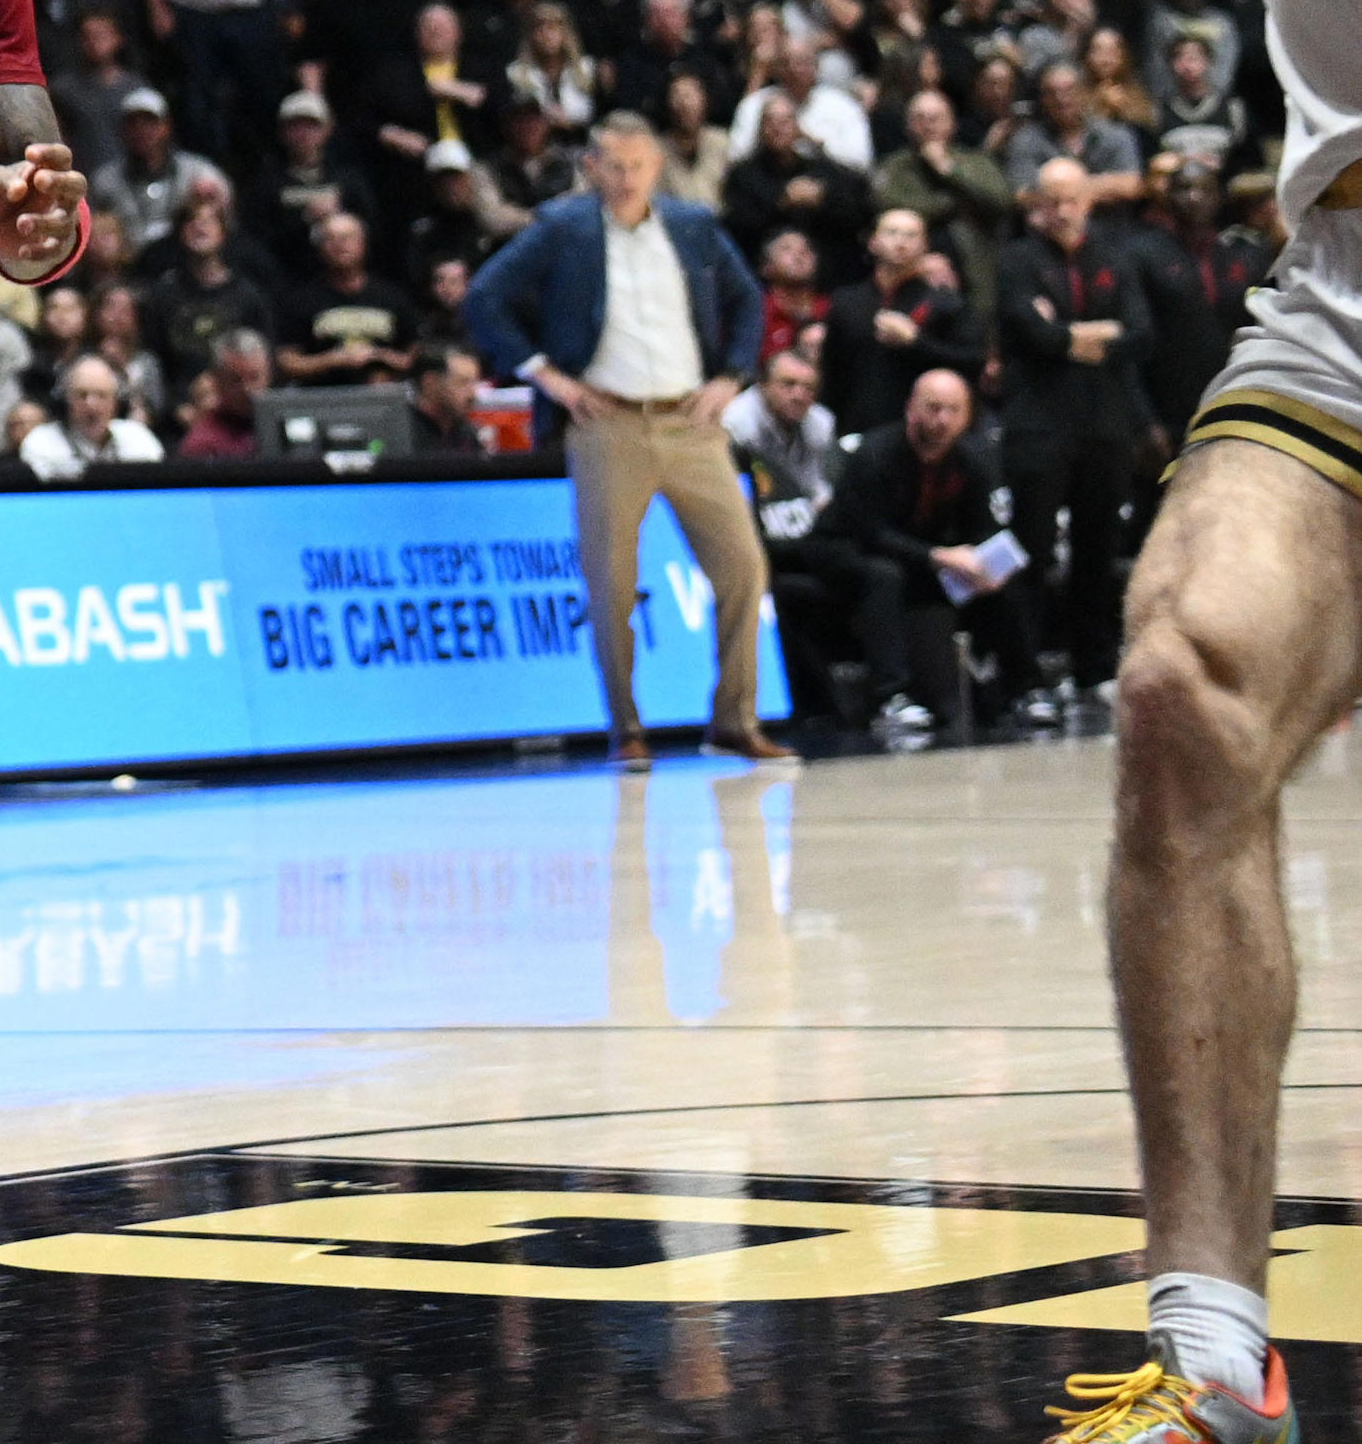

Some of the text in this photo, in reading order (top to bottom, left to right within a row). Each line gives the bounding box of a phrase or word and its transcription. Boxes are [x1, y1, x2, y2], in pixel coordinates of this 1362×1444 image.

[300, 537, 582, 591] SMALL STEPS TOWAR
[260, 602, 333, 670] BIG
[343, 595, 505, 666] CAREER
[509, 586, 656, 658] IMPT
